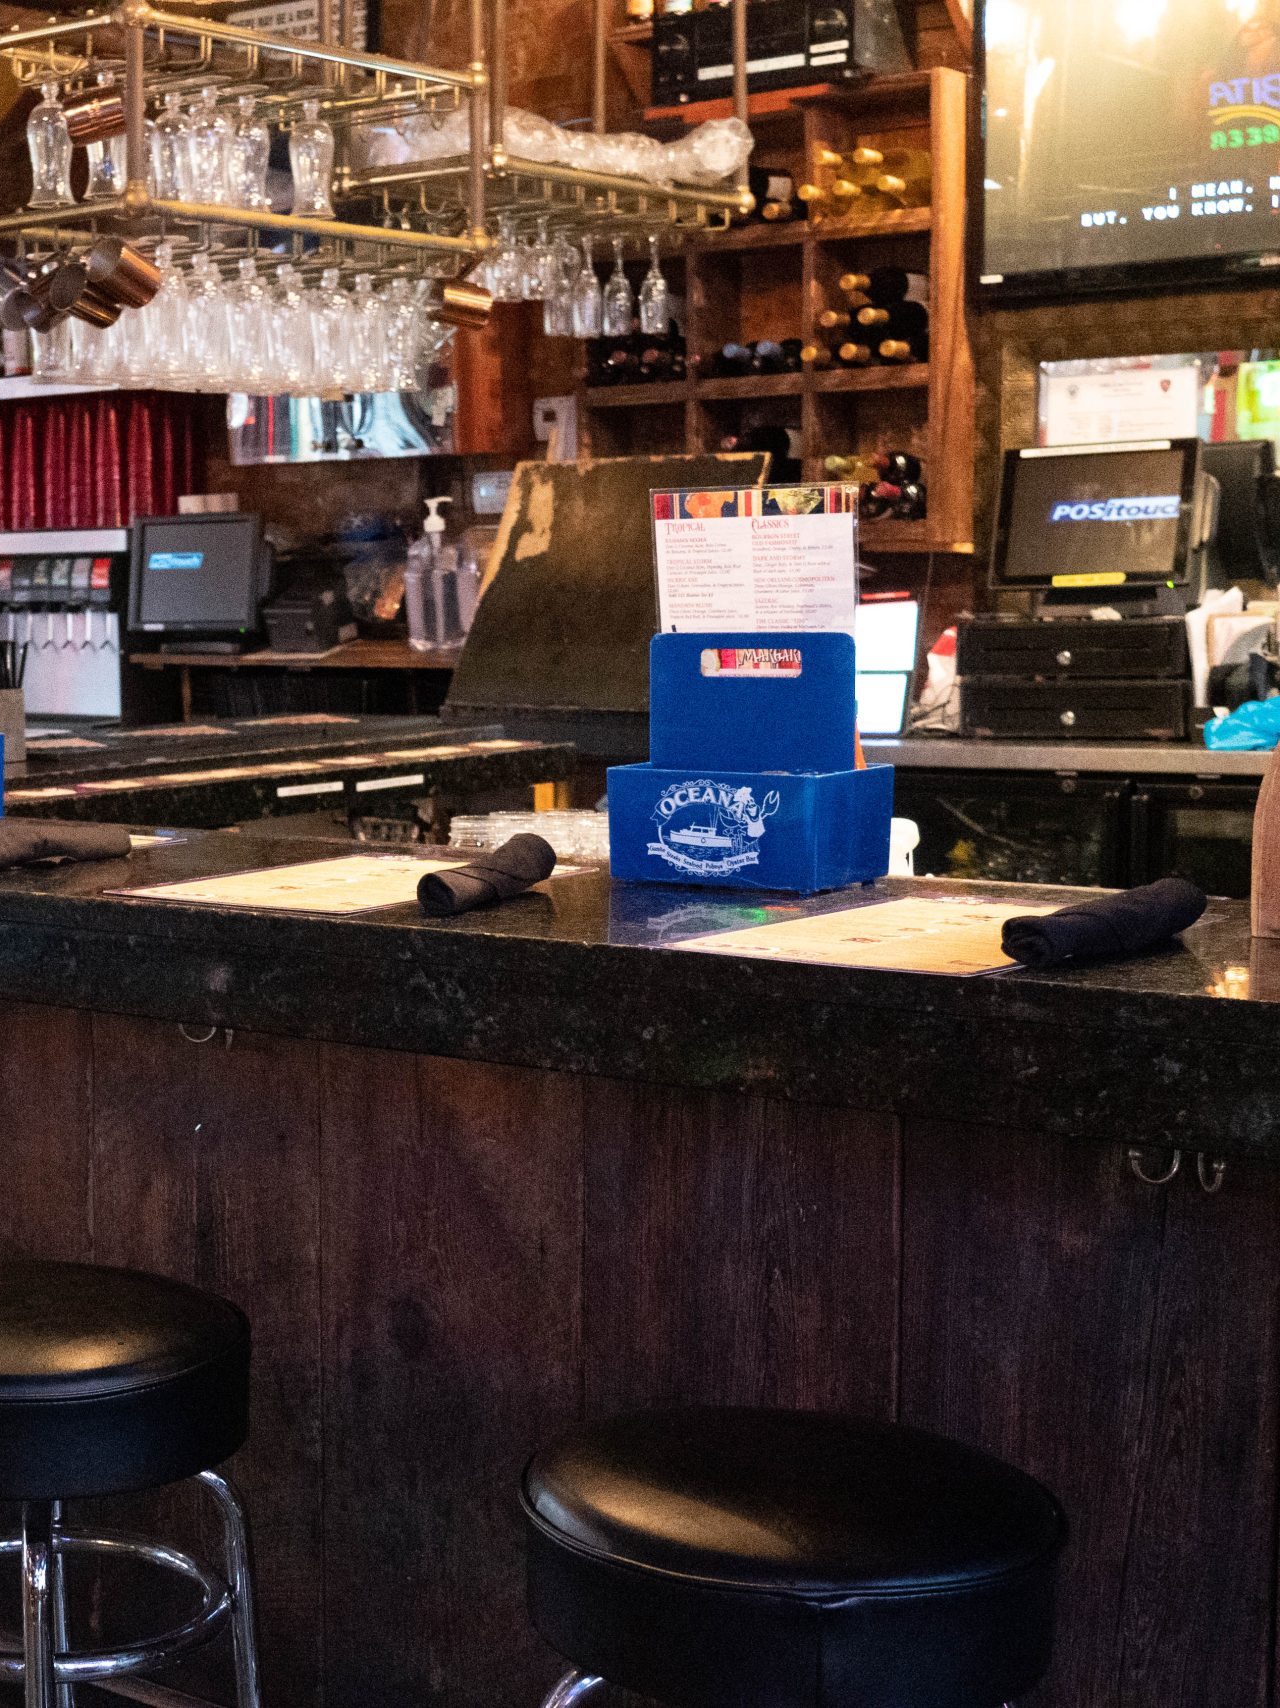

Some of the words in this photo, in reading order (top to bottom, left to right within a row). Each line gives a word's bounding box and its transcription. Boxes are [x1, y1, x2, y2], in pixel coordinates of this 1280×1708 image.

[1141, 204, 1180, 222] YOU
[1052, 502, 1180, 521] POSitouc
[751, 518, 790, 534] CLASSICS
[659, 786, 745, 821] OCEANA
[683, 858, 703, 869] Seafood
[726, 857, 745, 867] Oyster
